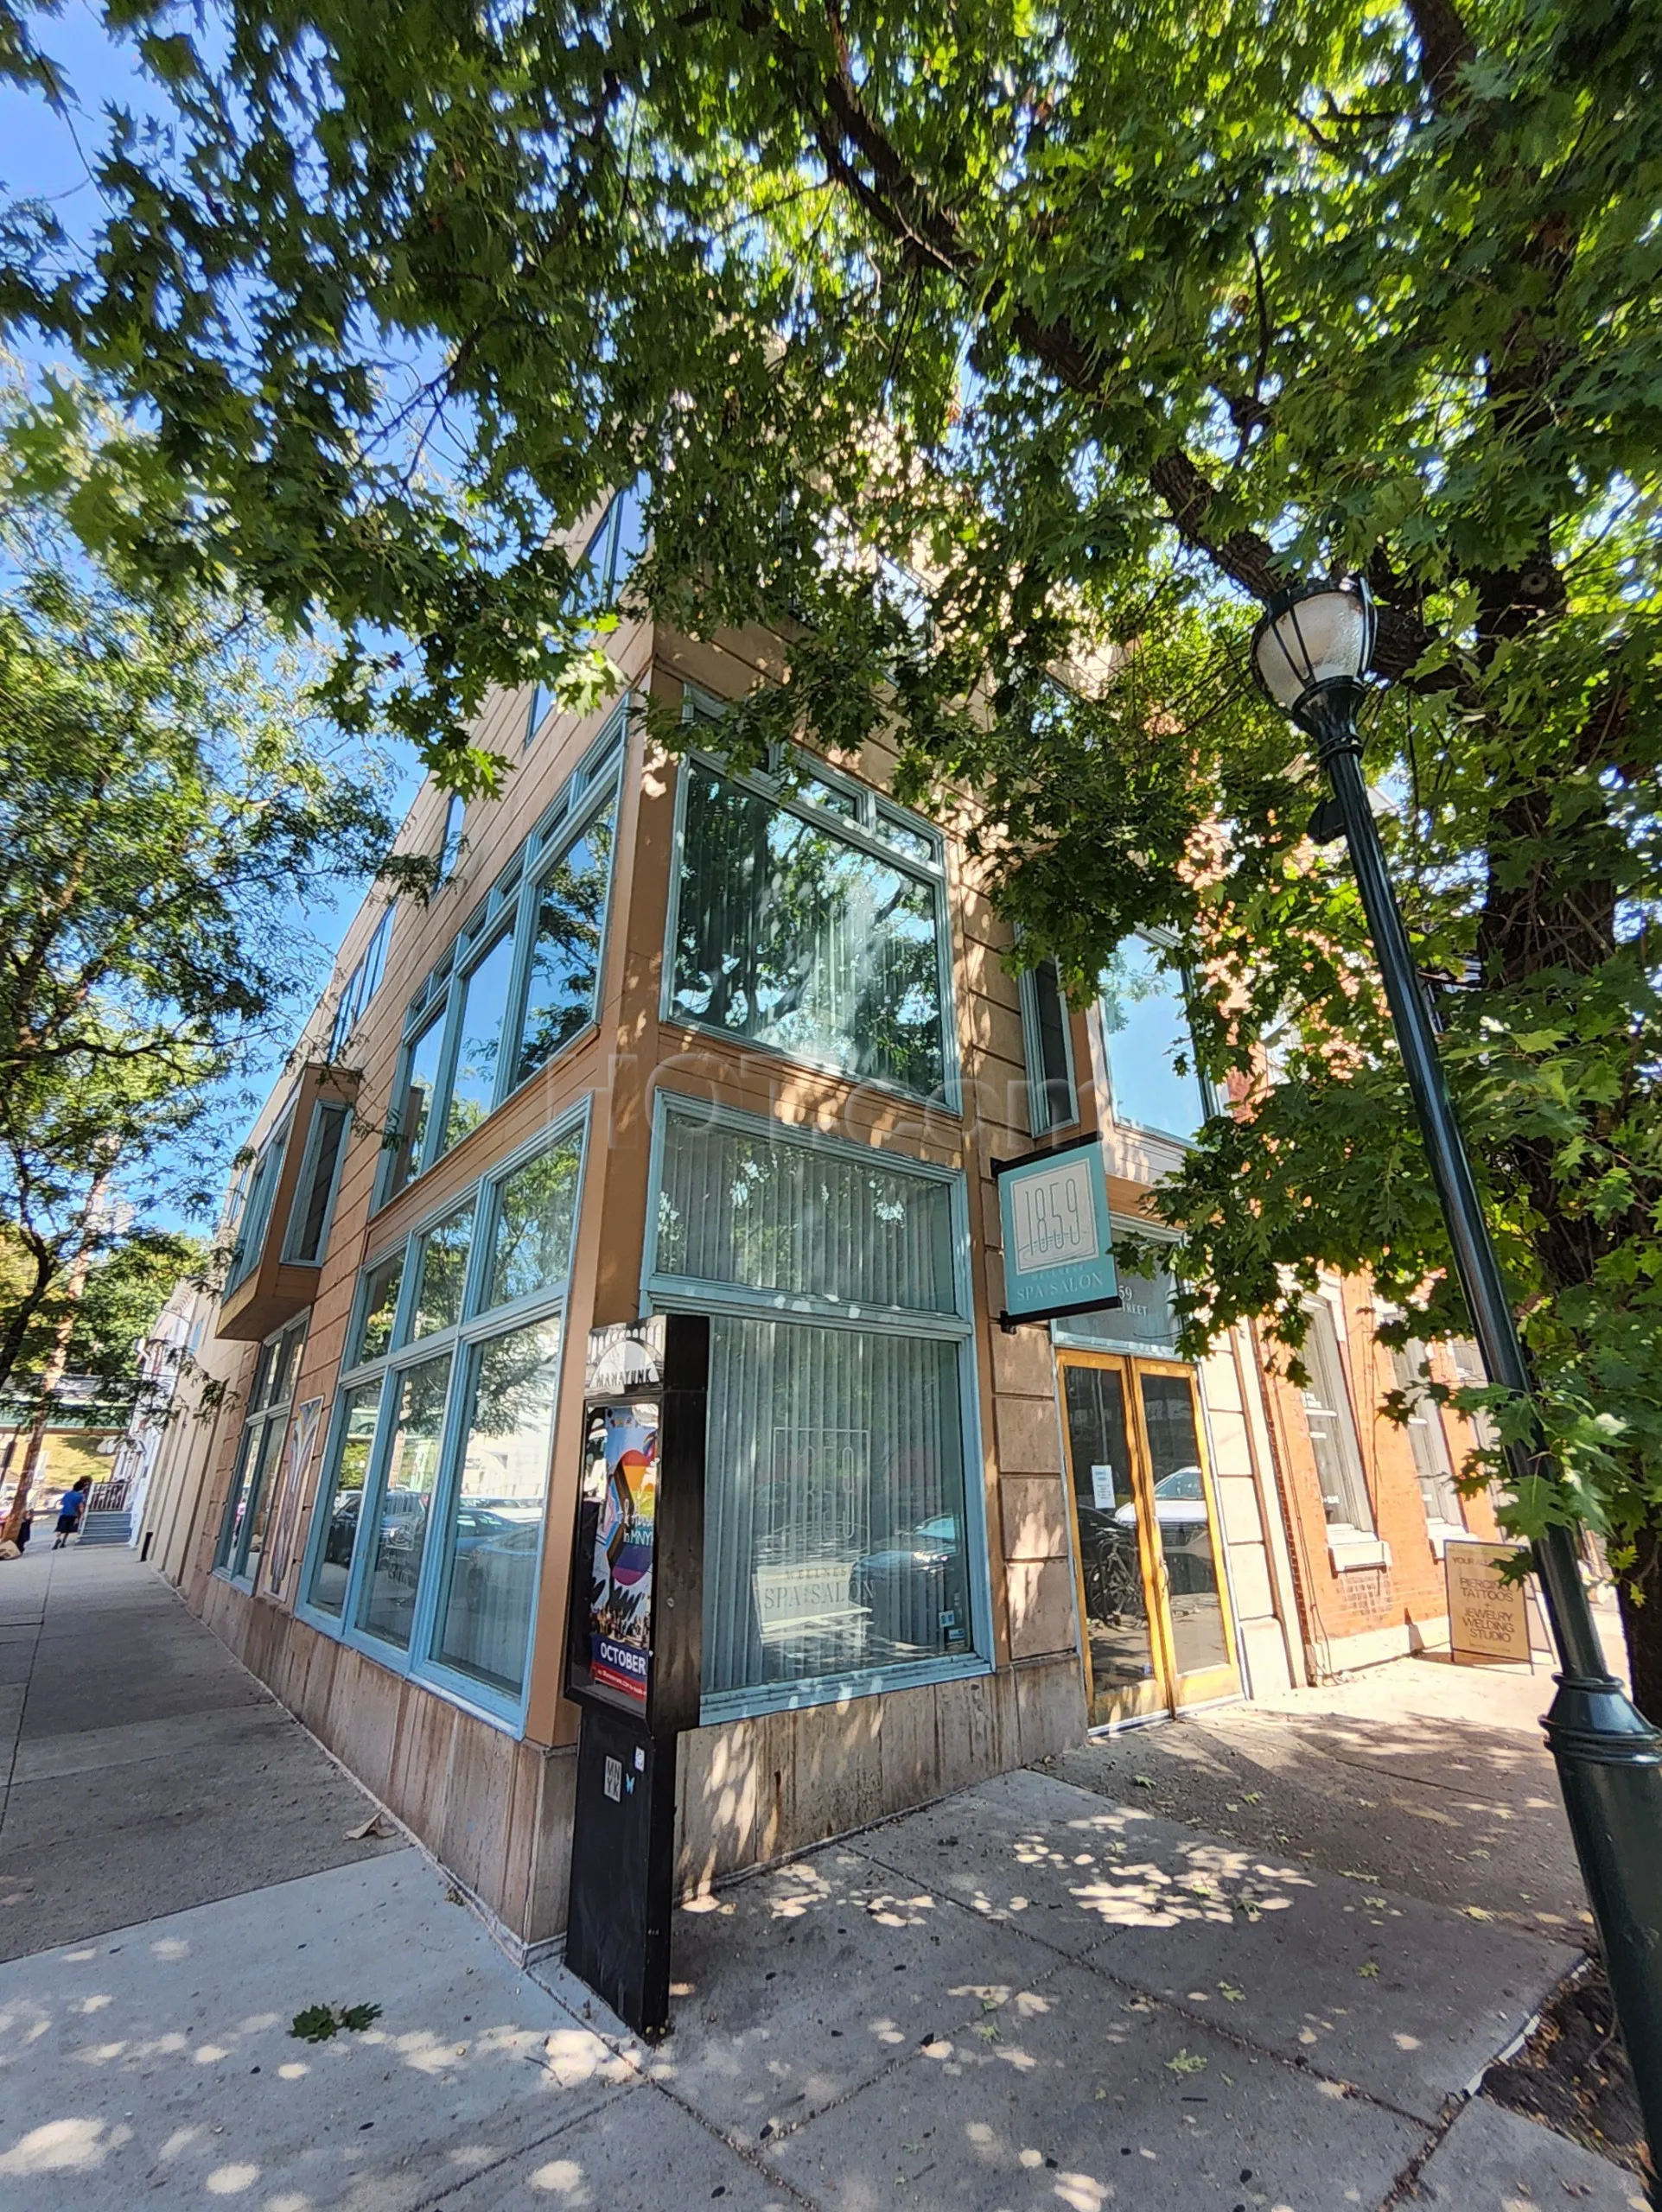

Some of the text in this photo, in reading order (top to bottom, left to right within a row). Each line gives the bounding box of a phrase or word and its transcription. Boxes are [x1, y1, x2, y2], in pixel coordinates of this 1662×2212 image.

[1025, 1178, 1081, 1256] 1859
[1016, 1282, 1045, 1302] SPA
[1049, 1271, 1105, 1295] SALON
[1116, 1300, 1149, 1318] TREET
[596, 1367, 653, 1389] MANAYUNK
[1452, 1556, 1474, 1566] YOUR
[811, 1579, 877, 1605] SALON
[1461, 1586, 1514, 1603] TATTOOS
[1465, 1606, 1513, 1622] JEWELRY
[1461, 1616, 1515, 1633] WELDING
[1469, 1628, 1512, 1643] STUDIO
[600, 1642, 646, 1675] OCTOBER
